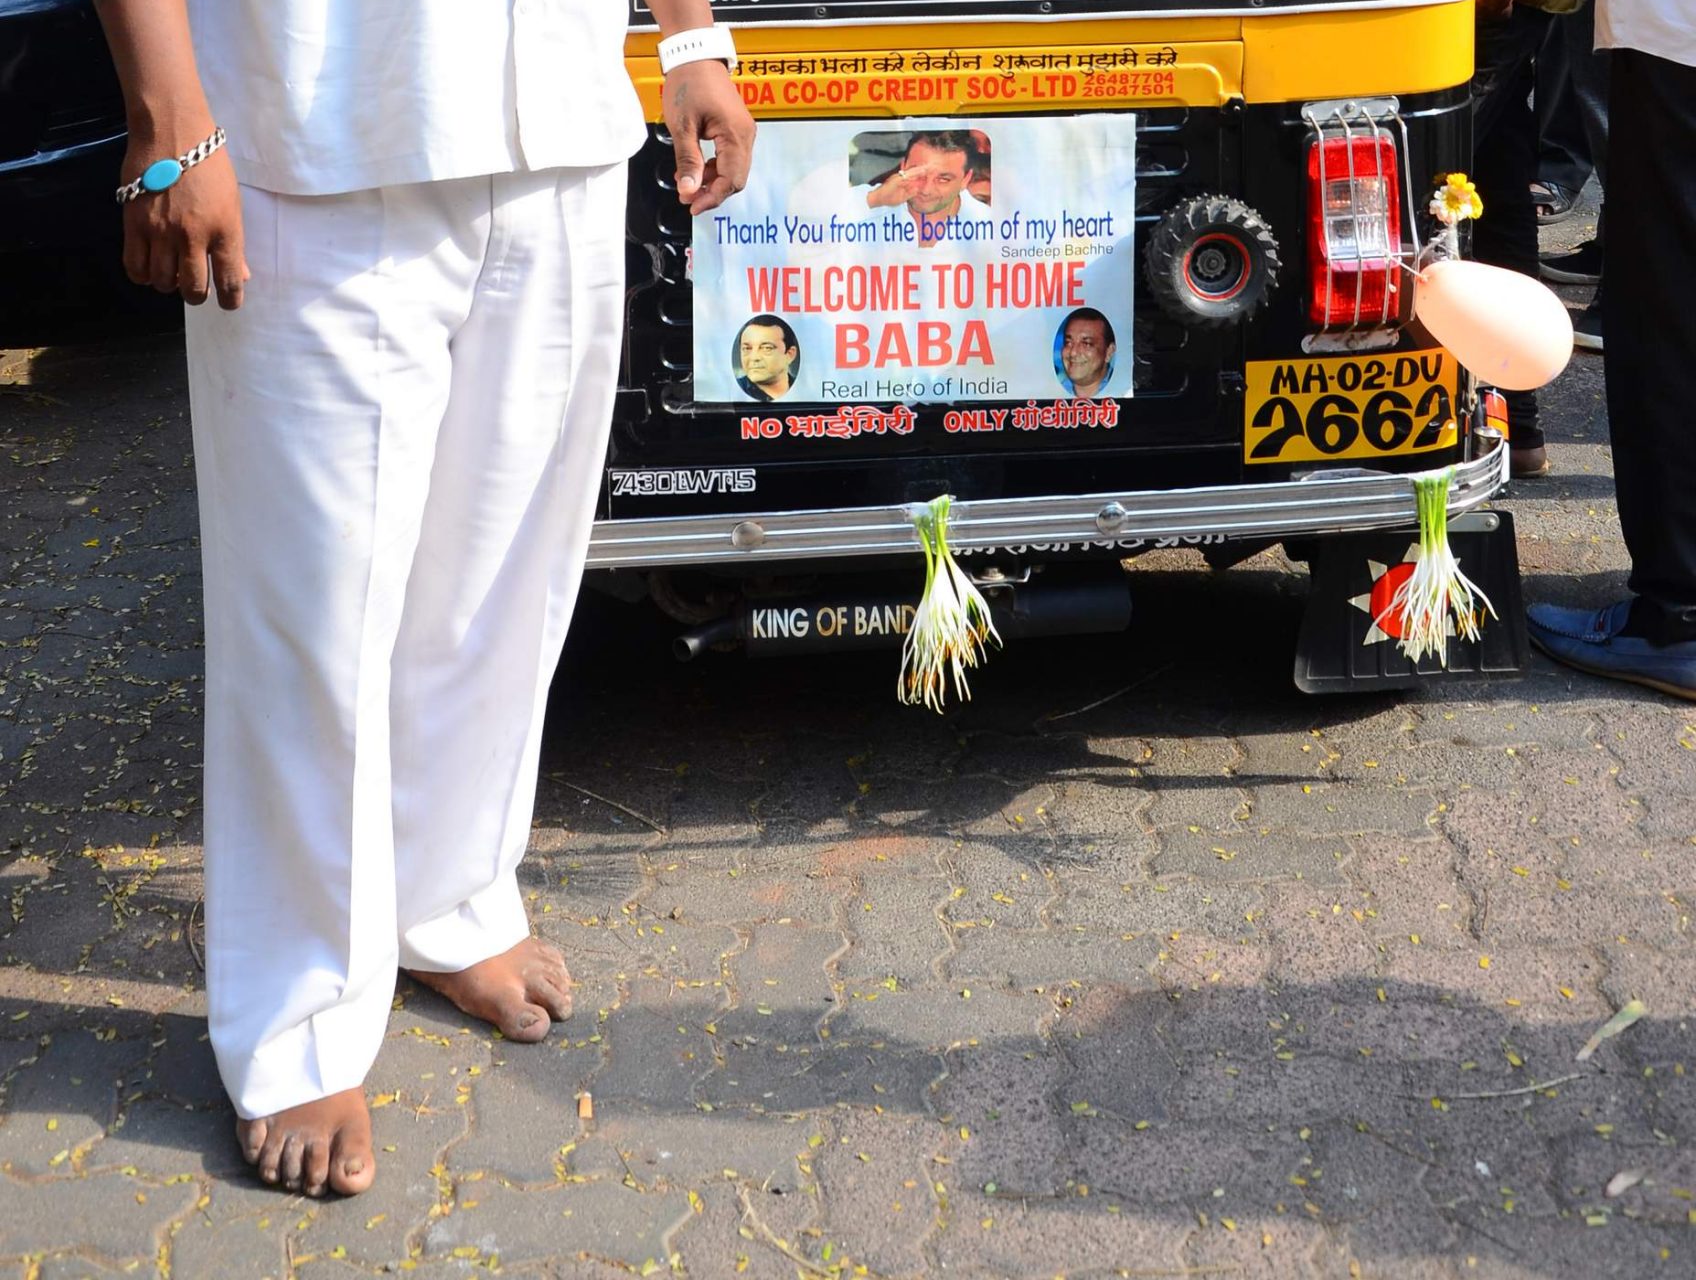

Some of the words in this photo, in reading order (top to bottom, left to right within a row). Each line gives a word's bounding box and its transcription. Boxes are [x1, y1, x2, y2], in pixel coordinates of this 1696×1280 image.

[748, 59, 816, 76] सबका
[820, 58, 868, 74] भला
[737, 80, 775, 105] DA
[783, 80, 859, 104] CO-OP
[868, 77, 958, 102] CREDIT
[714, 214, 778, 245] Thank
[783, 215, 823, 244] You
[830, 214, 879, 243] from
[884, 213, 915, 242] the
[921, 212, 995, 241] bottom
[1000, 211, 1021, 240] of
[1026, 217, 1056, 245] my
[1063, 210, 1114, 238] heart
[1001, 245, 1060, 259] Sandeep
[747, 263, 921, 313] WELCOME
[932, 263, 975, 309] TO
[986, 261, 1086, 308] HOME
[834, 320, 995, 370] BABA
[821, 380, 868, 399] Real
[876, 380, 925, 398] Hero
[933, 379, 952, 396] of
[960, 378, 1008, 396] India
[741, 416, 783, 440] NO
[785, 404, 917, 439] भाईगिरी
[943, 409, 1009, 434] ONLY
[1012, 396, 1120, 430] गांधीगिरी
[1250, 384, 1456, 458] 2662
[753, 608, 809, 638] KING
[817, 607, 847, 637] OF
